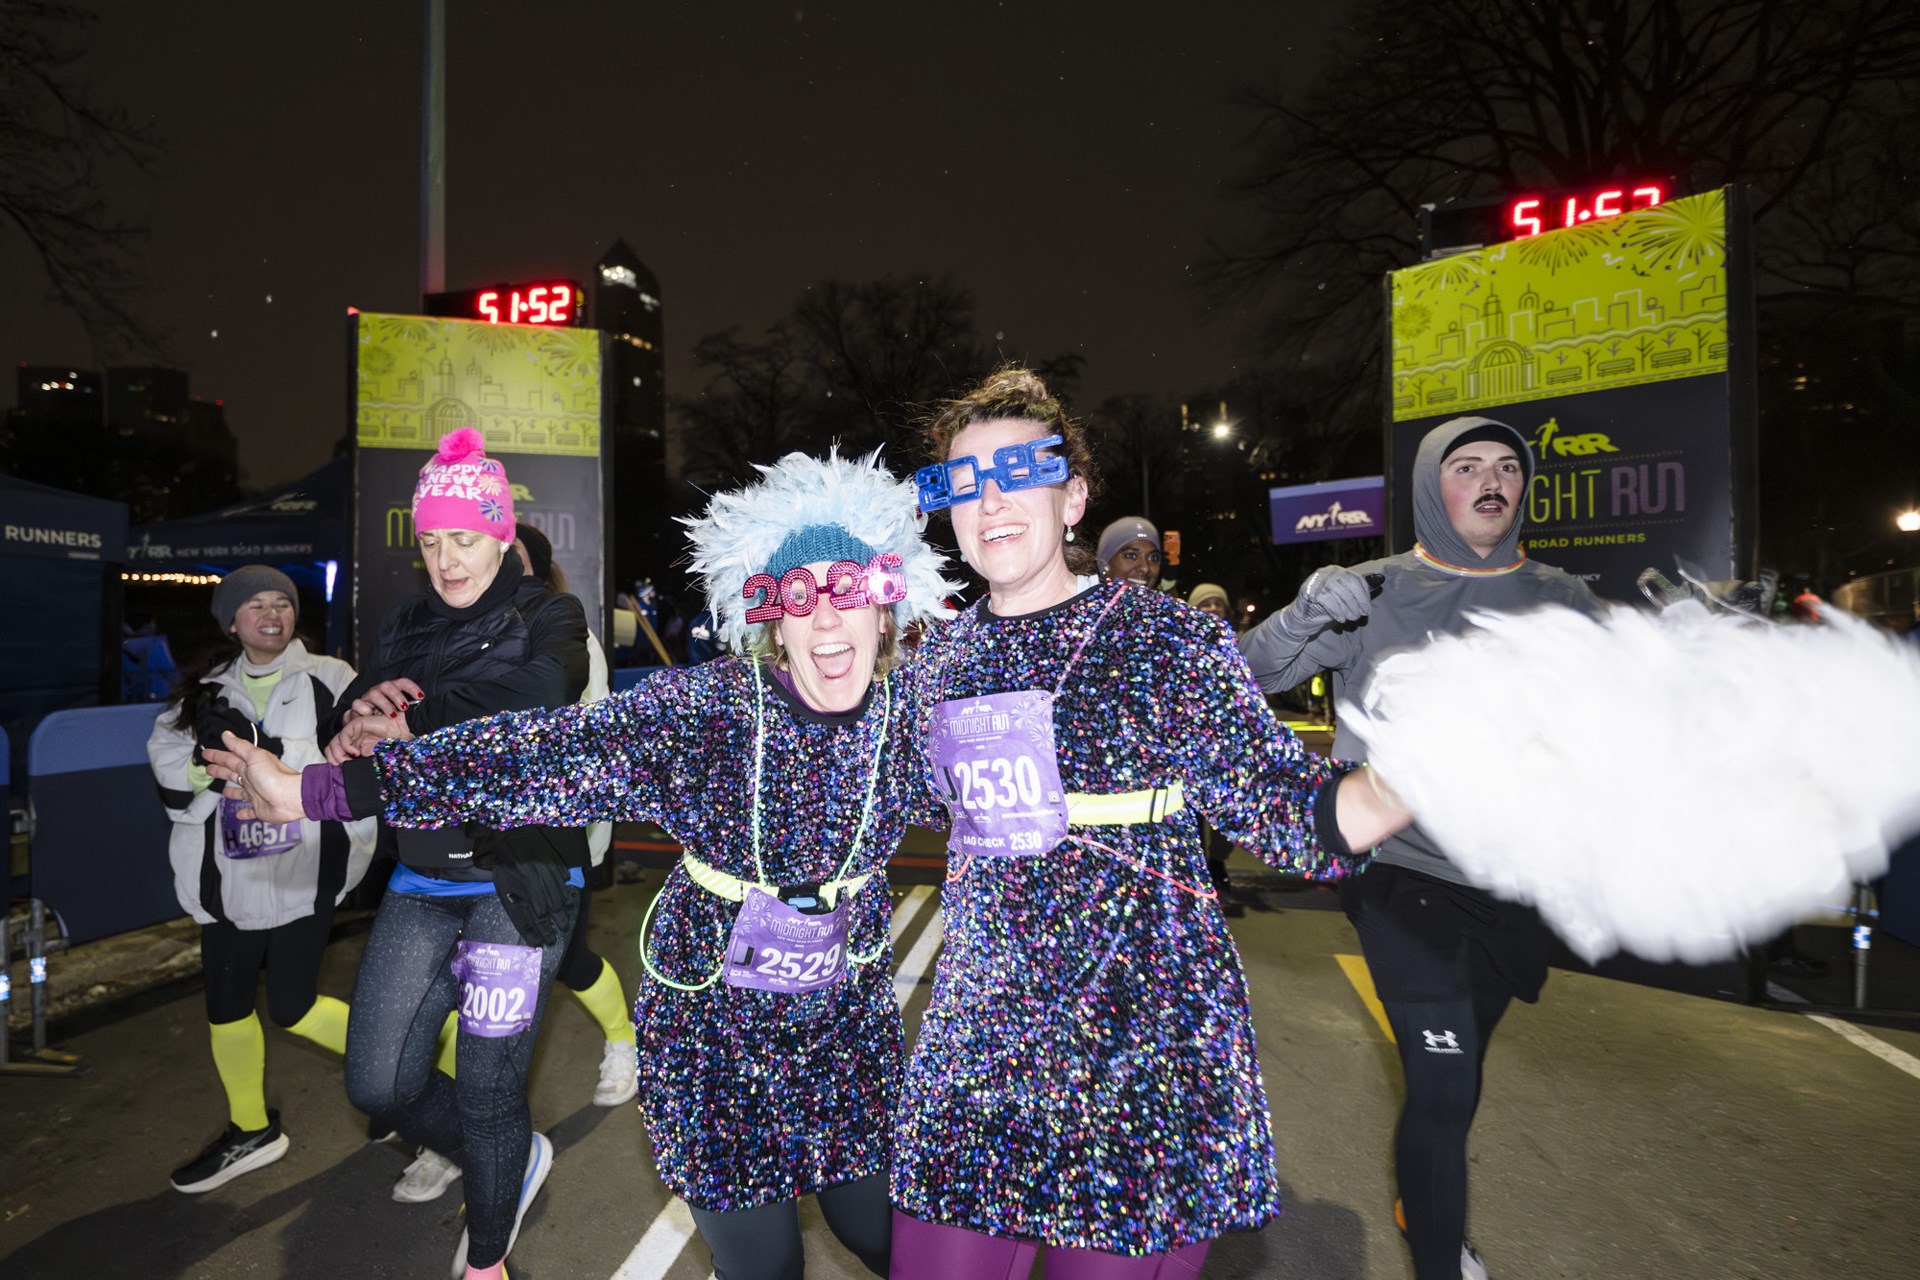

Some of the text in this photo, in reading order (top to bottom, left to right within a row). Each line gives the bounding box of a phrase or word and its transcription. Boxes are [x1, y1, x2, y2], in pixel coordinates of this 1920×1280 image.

[425, 463, 483, 477] HAPPY
[426, 473, 477, 487] NEW
[419, 484, 484, 502] YEAR
[1611, 461, 1685, 517] RUN
[4, 524, 102, 549] RUNNERS
[1529, 537, 1569, 550] ROAD
[1573, 533, 1647, 547] RUNNERS
[743, 552, 907, 625] 2026
[949, 713, 1010, 737] MIDNIGHT RUN
[954, 755, 1042, 810] 2530
[224, 828, 239, 850] H
[963, 830, 1042, 850] BAG CHECK 2530
[769, 918, 818, 940] MIDNIGHT
[817, 924, 834, 938] RUN
[497, 958, 511, 971] RUN
[756, 942, 841, 981] 2529
[462, 982, 526, 1022] 2002
